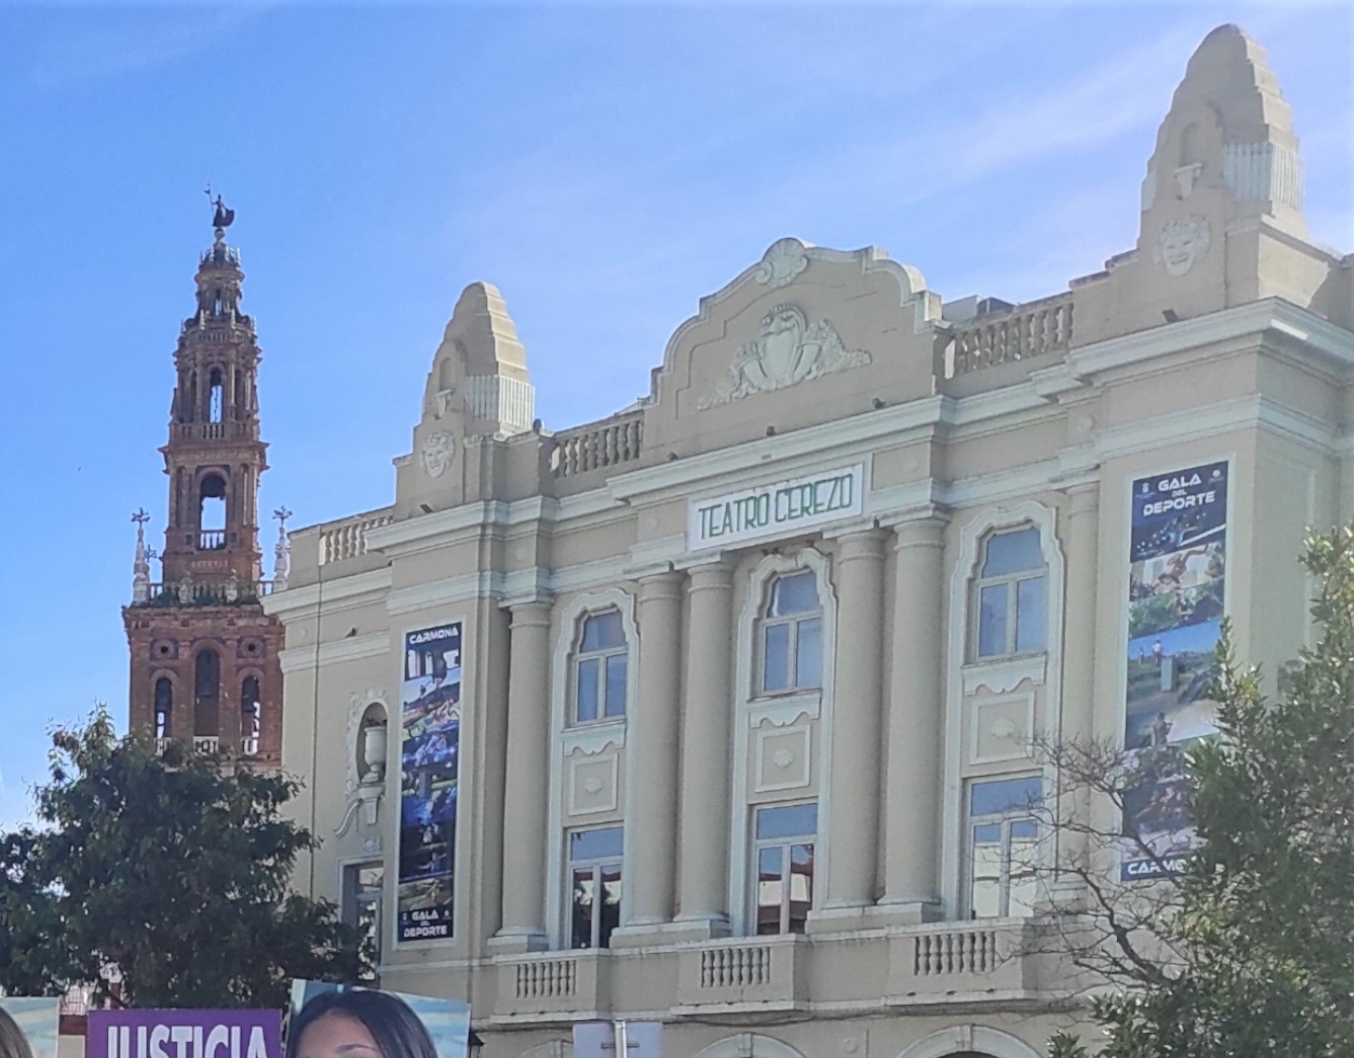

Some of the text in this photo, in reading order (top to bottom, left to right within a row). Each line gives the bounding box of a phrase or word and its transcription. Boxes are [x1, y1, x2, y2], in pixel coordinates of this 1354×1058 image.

[1158, 473, 1202, 492] GALA
[698, 473, 854, 540] TEATRO CEREZO
[1143, 490, 1216, 516] DEPORTE
[409, 626, 459, 645] CARMONA
[411, 909, 439, 921] GALA
[403, 924, 448, 938] DEPORTE
